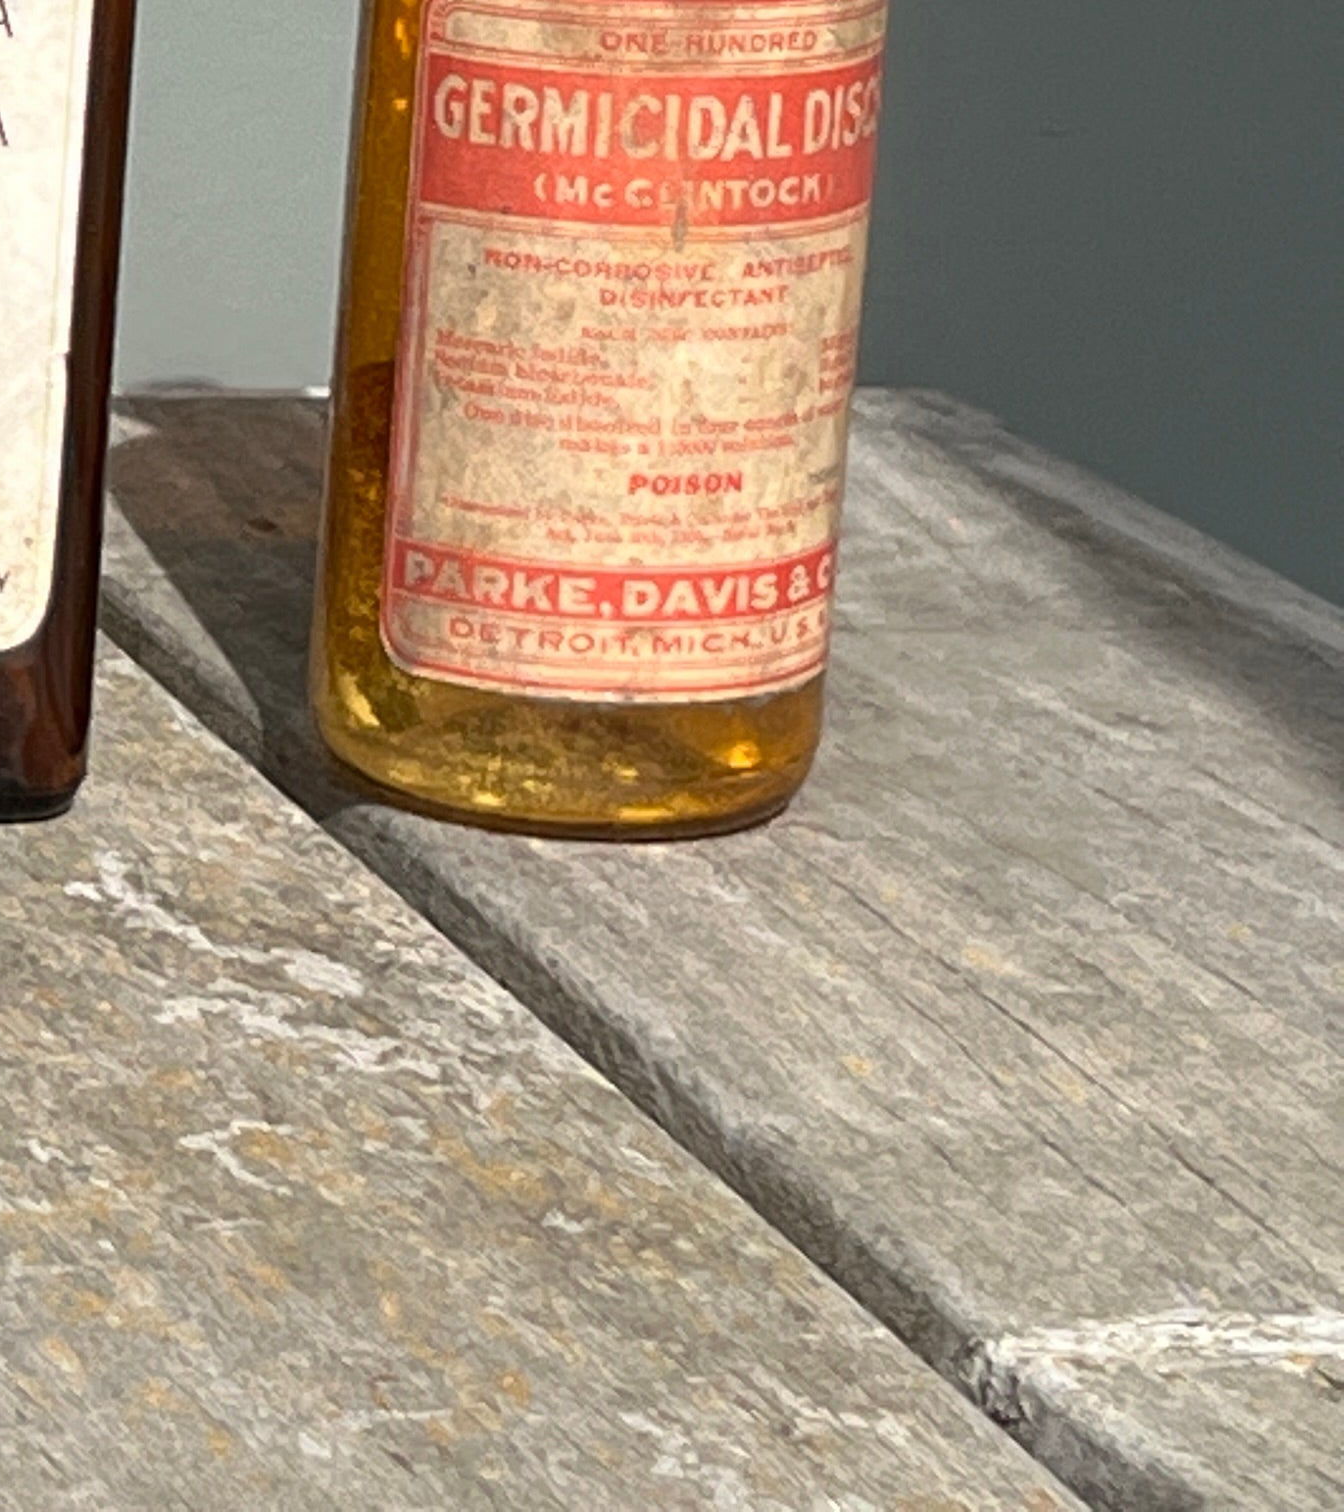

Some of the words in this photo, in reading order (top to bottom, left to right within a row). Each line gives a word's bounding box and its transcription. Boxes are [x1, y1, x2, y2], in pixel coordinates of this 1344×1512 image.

[599, 30, 669, 55] ONE
[685, 30, 819, 55] HUNDRED
[433, 73, 793, 162] GERMICIDAL
[484, 246, 716, 283] NON-CORROSIVE
[598, 284, 791, 310] DISINFECTANT
[627, 471, 743, 497] POISON
[403, 549, 613, 620] PARKE,
[621, 572, 779, 618] DAVIS
[786, 563, 811, 603] &
